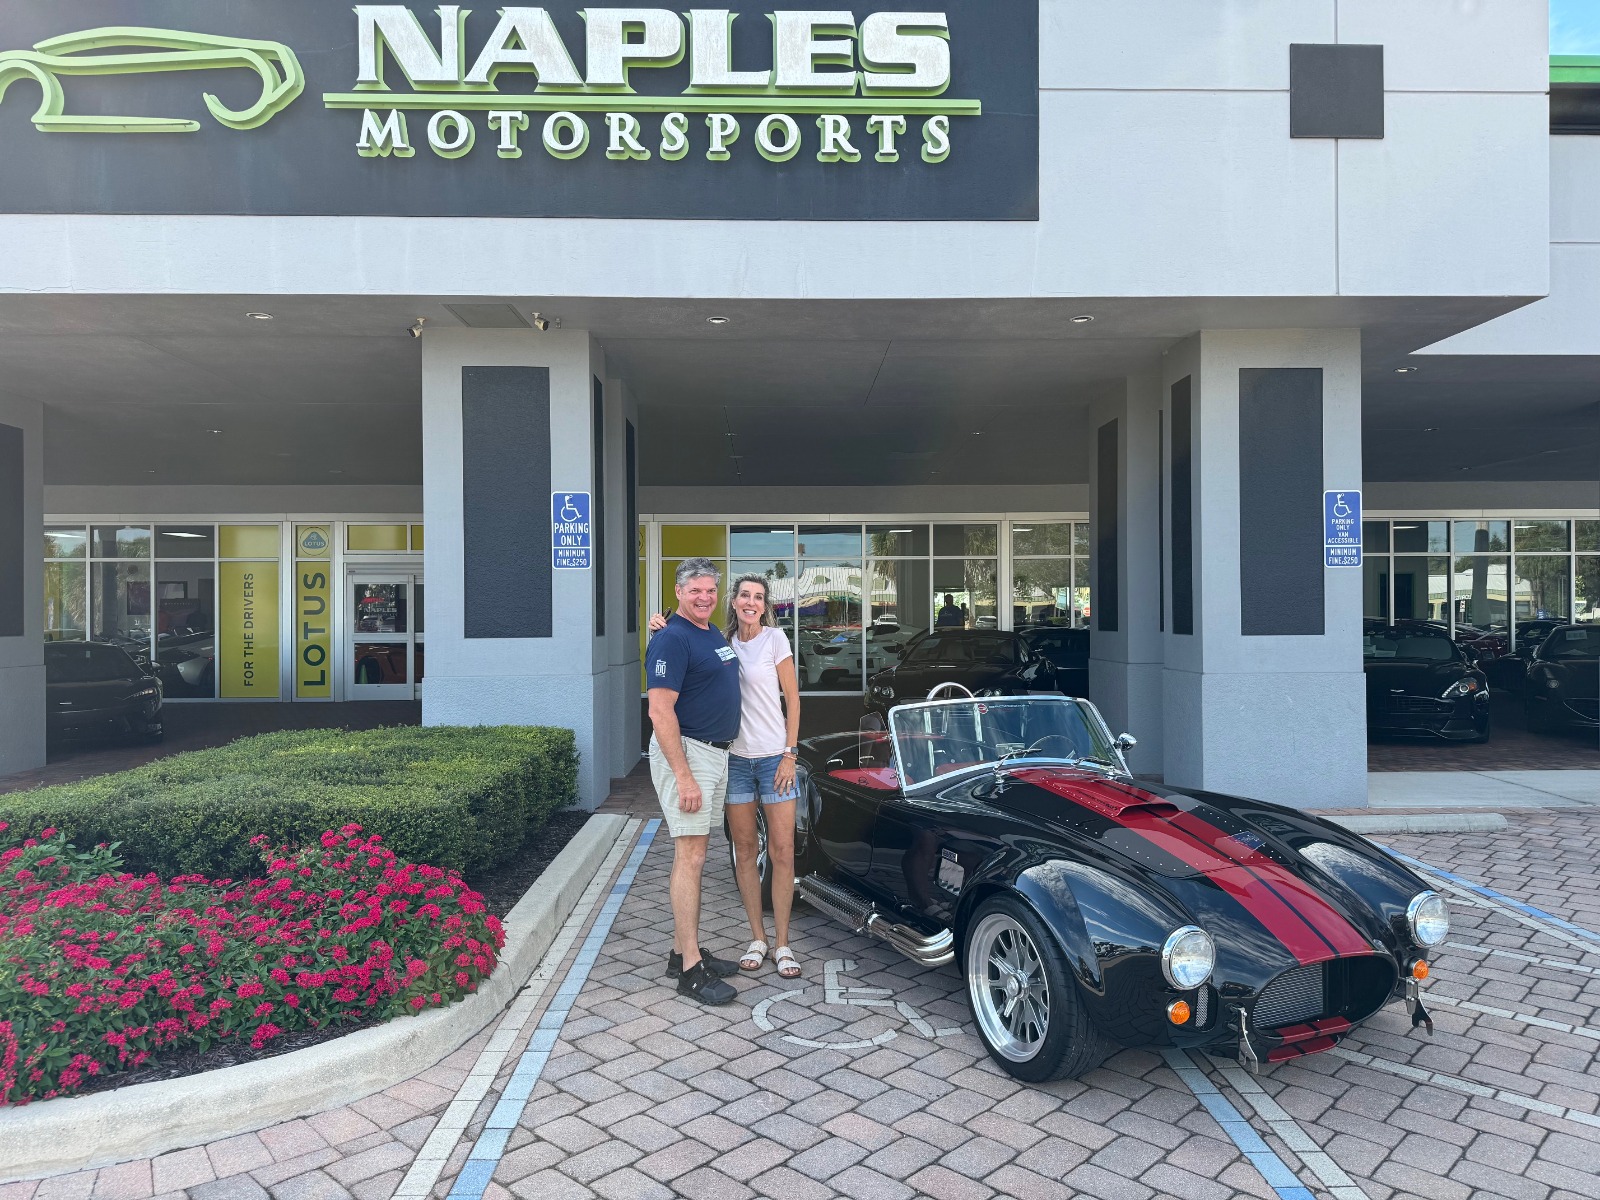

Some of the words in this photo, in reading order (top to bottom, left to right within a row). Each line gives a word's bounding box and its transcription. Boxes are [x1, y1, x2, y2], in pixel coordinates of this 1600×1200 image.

[355, 4, 952, 95] NAPLES
[356, 108, 952, 163] MOTORSPORTS
[554, 523, 588, 534] PARKING
[560, 535, 582, 546] ONLY
[243, 572, 254, 629] DRIVERS
[243, 632, 254, 658] THE
[303, 572, 326, 687] LOTUS
[243, 661, 254, 687] FOR
